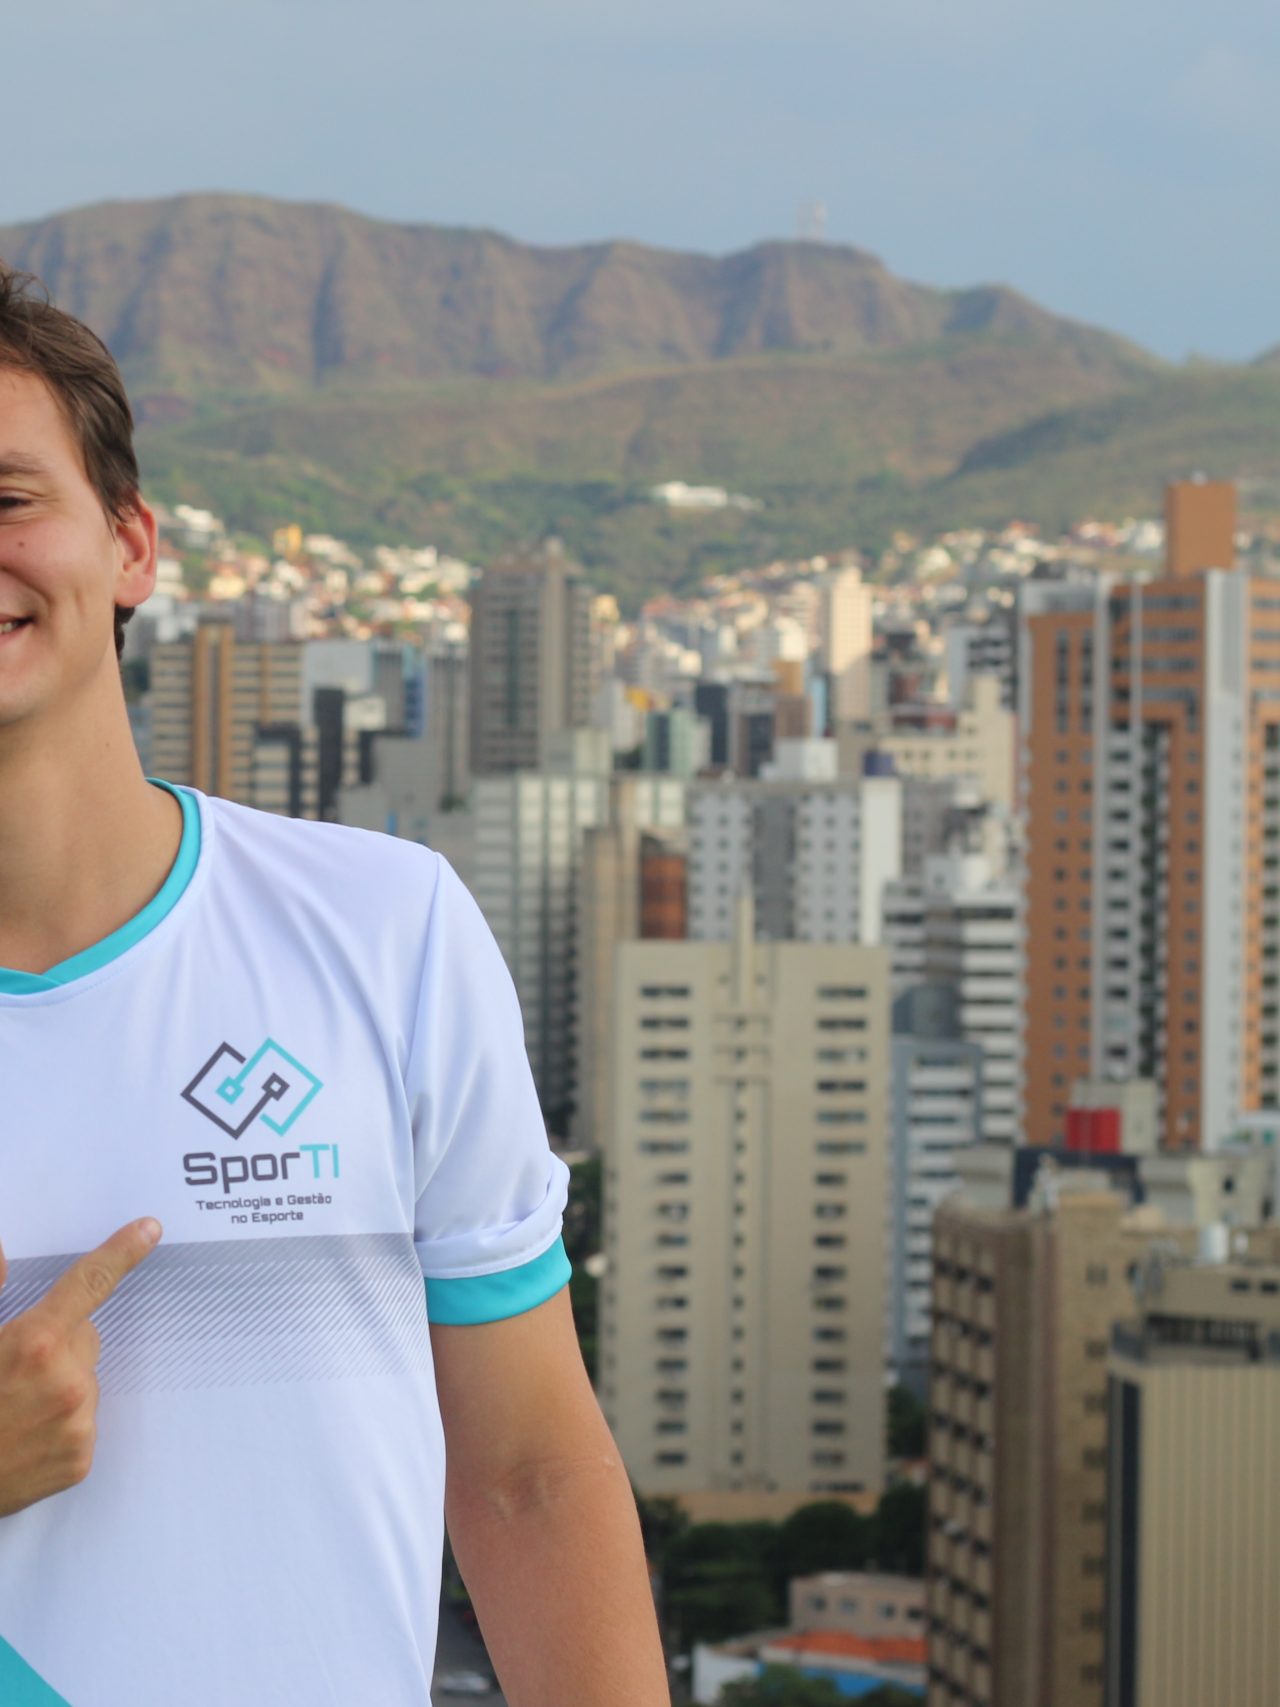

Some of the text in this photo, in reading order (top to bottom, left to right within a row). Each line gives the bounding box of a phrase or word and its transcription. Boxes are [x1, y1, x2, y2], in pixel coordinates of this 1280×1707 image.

[183, 1144, 339, 1194] SporTI
[195, 1193, 332, 1210] Tecnologia e Gestão
[231, 1210, 304, 1224] no Esporte
